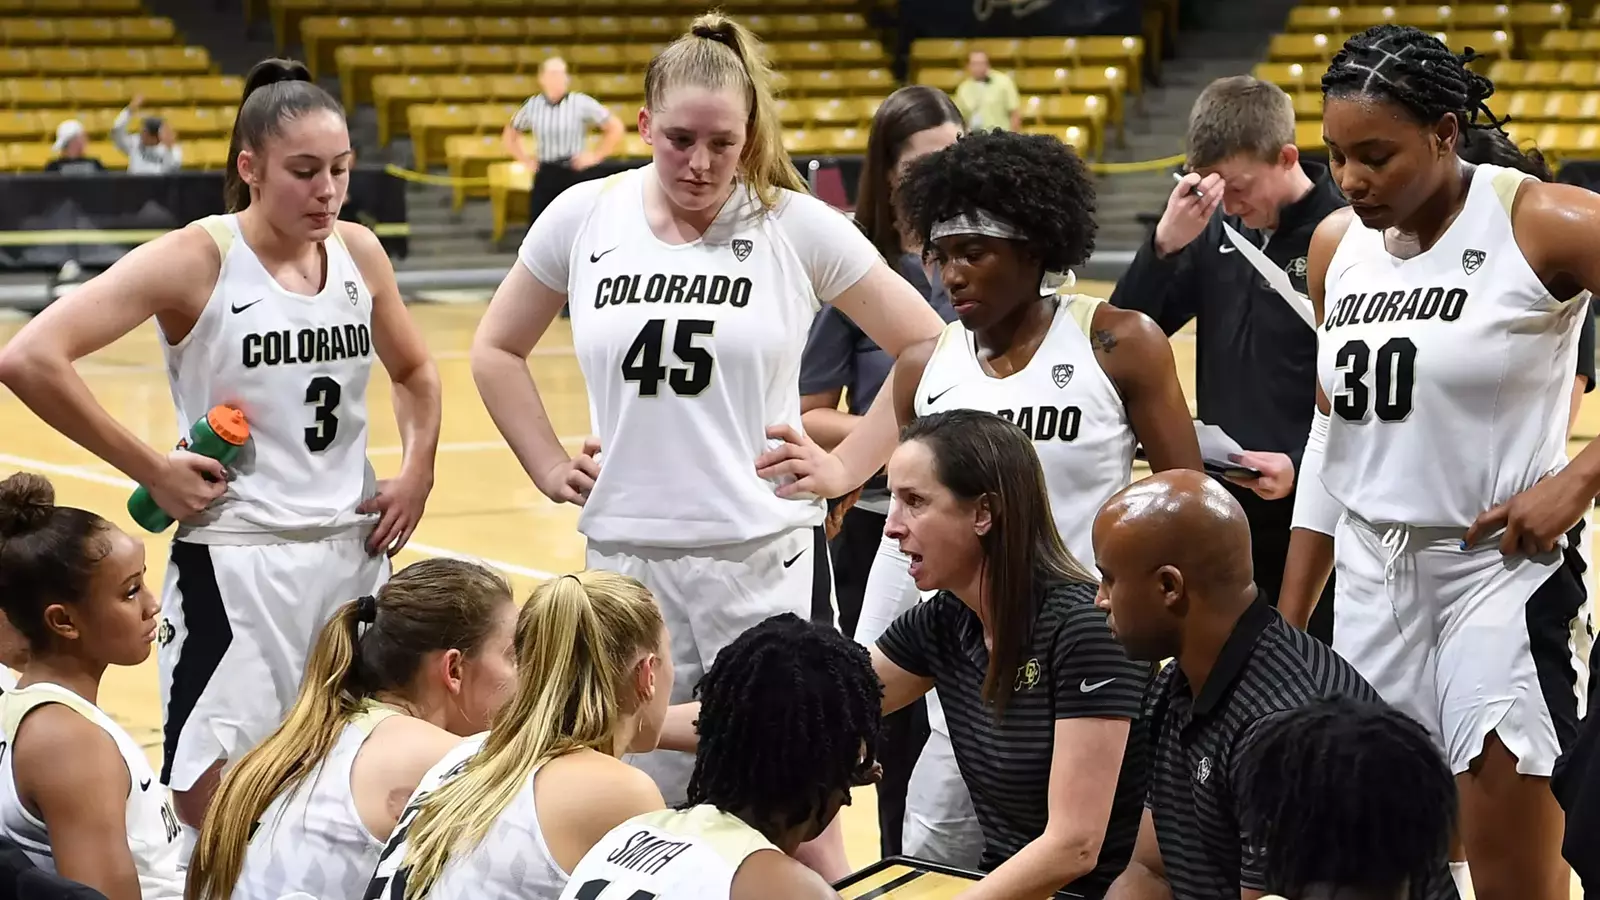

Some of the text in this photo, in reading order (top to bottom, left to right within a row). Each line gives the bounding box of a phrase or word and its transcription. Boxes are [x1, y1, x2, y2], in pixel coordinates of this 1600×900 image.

[594, 274, 752, 309] COLORADO
[1325, 287, 1468, 332] COLORADO
[242, 324, 370, 367] COLORADO
[621, 319, 715, 397] 45
[1334, 338, 1418, 424] 30
[304, 376, 341, 453] 3
[607, 831, 693, 875] SMITH
